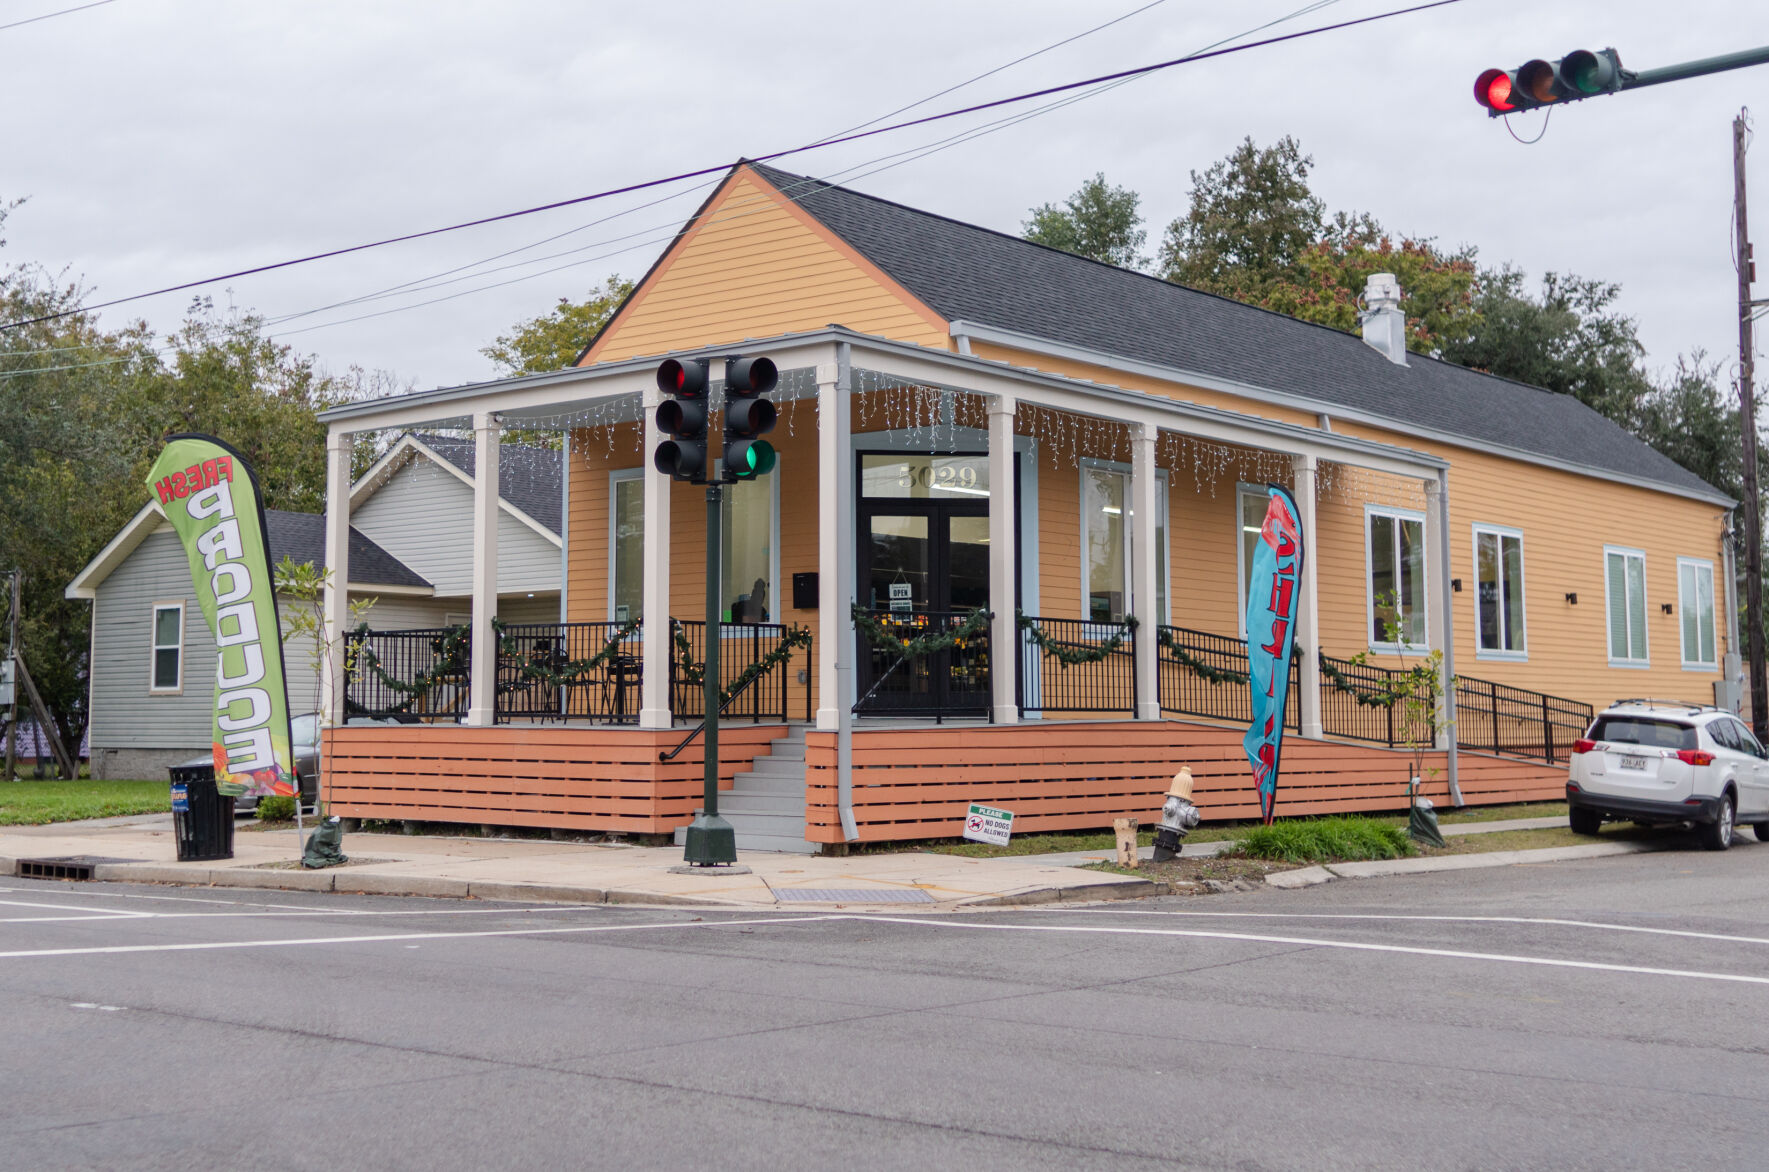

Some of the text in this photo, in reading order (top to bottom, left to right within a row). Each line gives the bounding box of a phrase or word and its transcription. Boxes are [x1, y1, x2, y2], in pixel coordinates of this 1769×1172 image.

[899, 466, 976, 488] 5029
[893, 589, 907, 597] OPEN
[979, 808, 1003, 818] PLEASE
[985, 819, 1010, 830] NO DOGS
[984, 828, 1008, 838] ALLOWED
